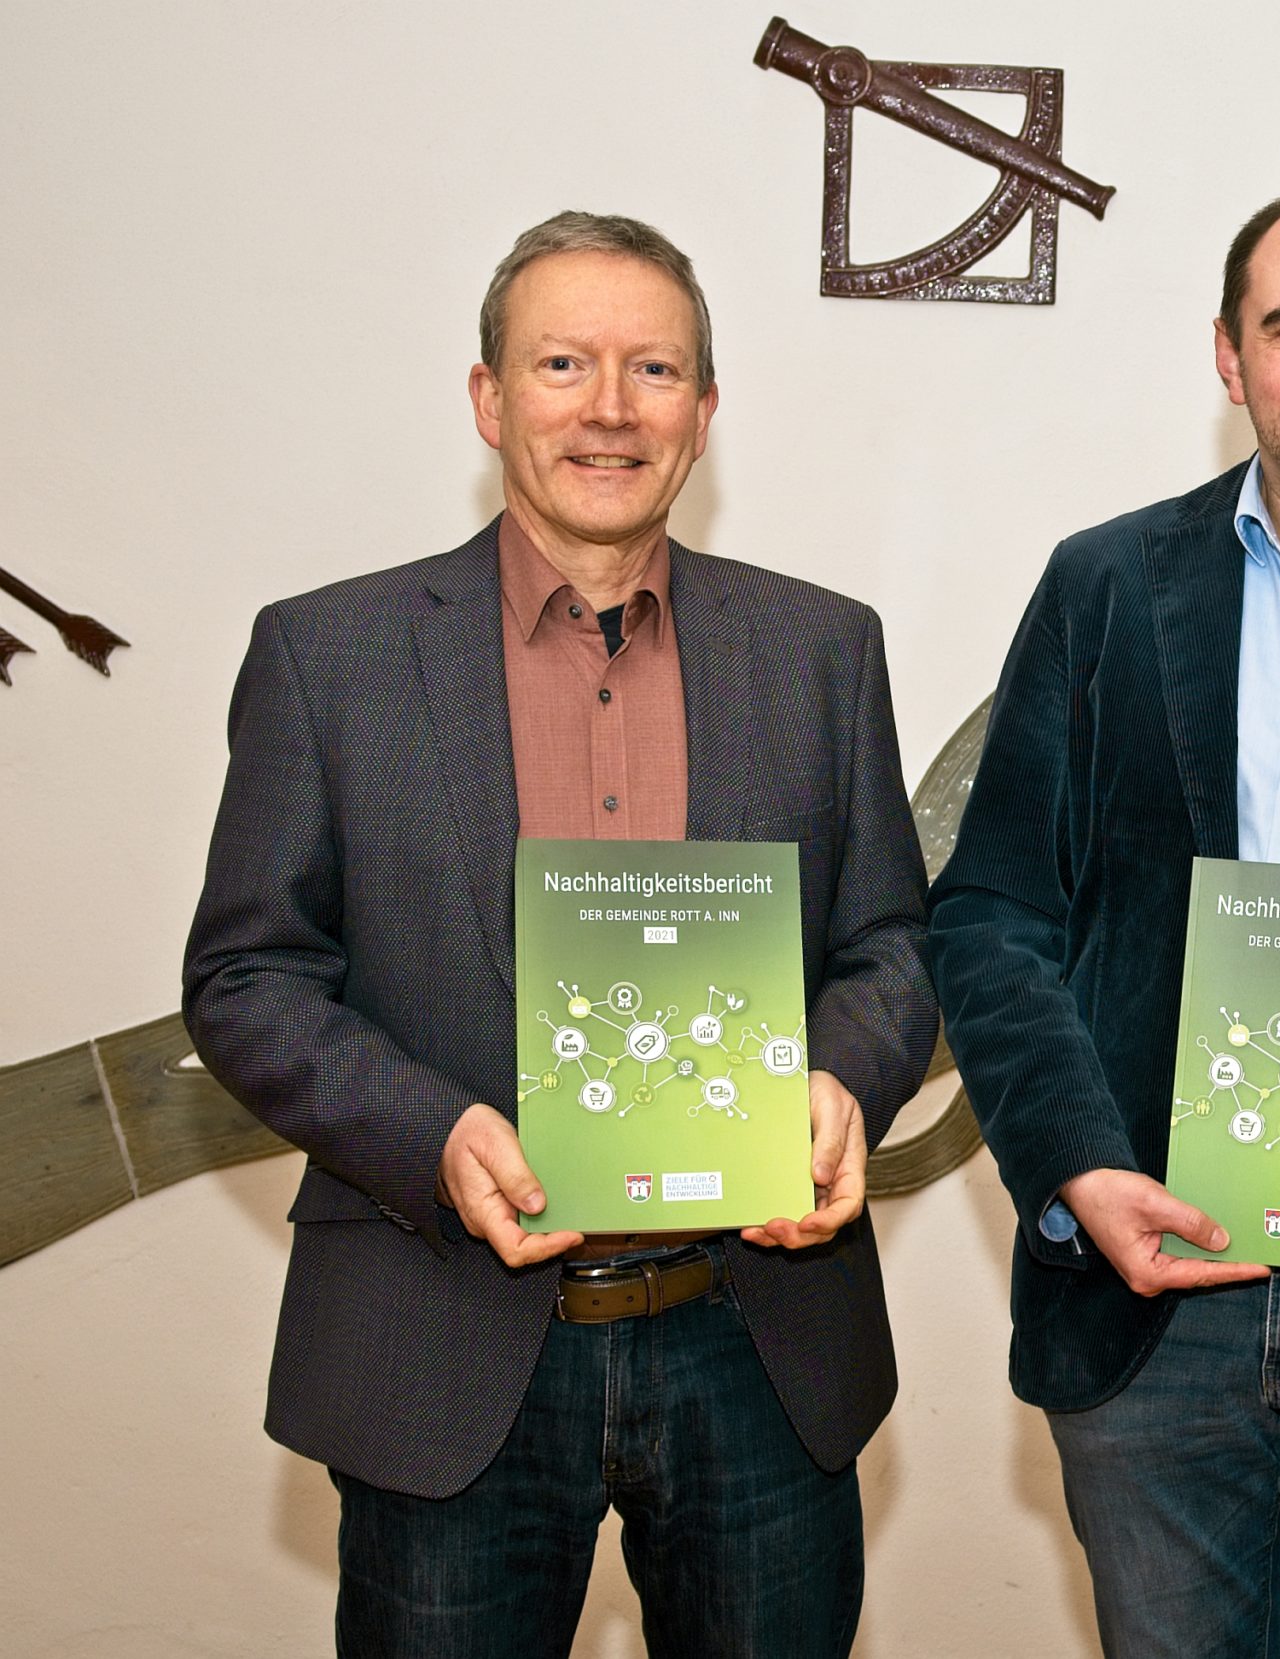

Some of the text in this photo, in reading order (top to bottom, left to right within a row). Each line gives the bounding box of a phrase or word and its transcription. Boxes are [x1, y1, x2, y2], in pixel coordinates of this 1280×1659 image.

[544, 871, 773, 898] Nachhaltigkeitsbericht
[579, 908, 740, 922] DER GEMEINDE ROTT A. INN
[647, 930, 675, 941] 2021
[1248, 935, 1271, 948] DER
[666, 1175, 707, 1184] ZIELE FÜR
[666, 1183, 718, 1191] NACHHALTIGE
[666, 1190, 718, 1198] ENTWICKLUNG
